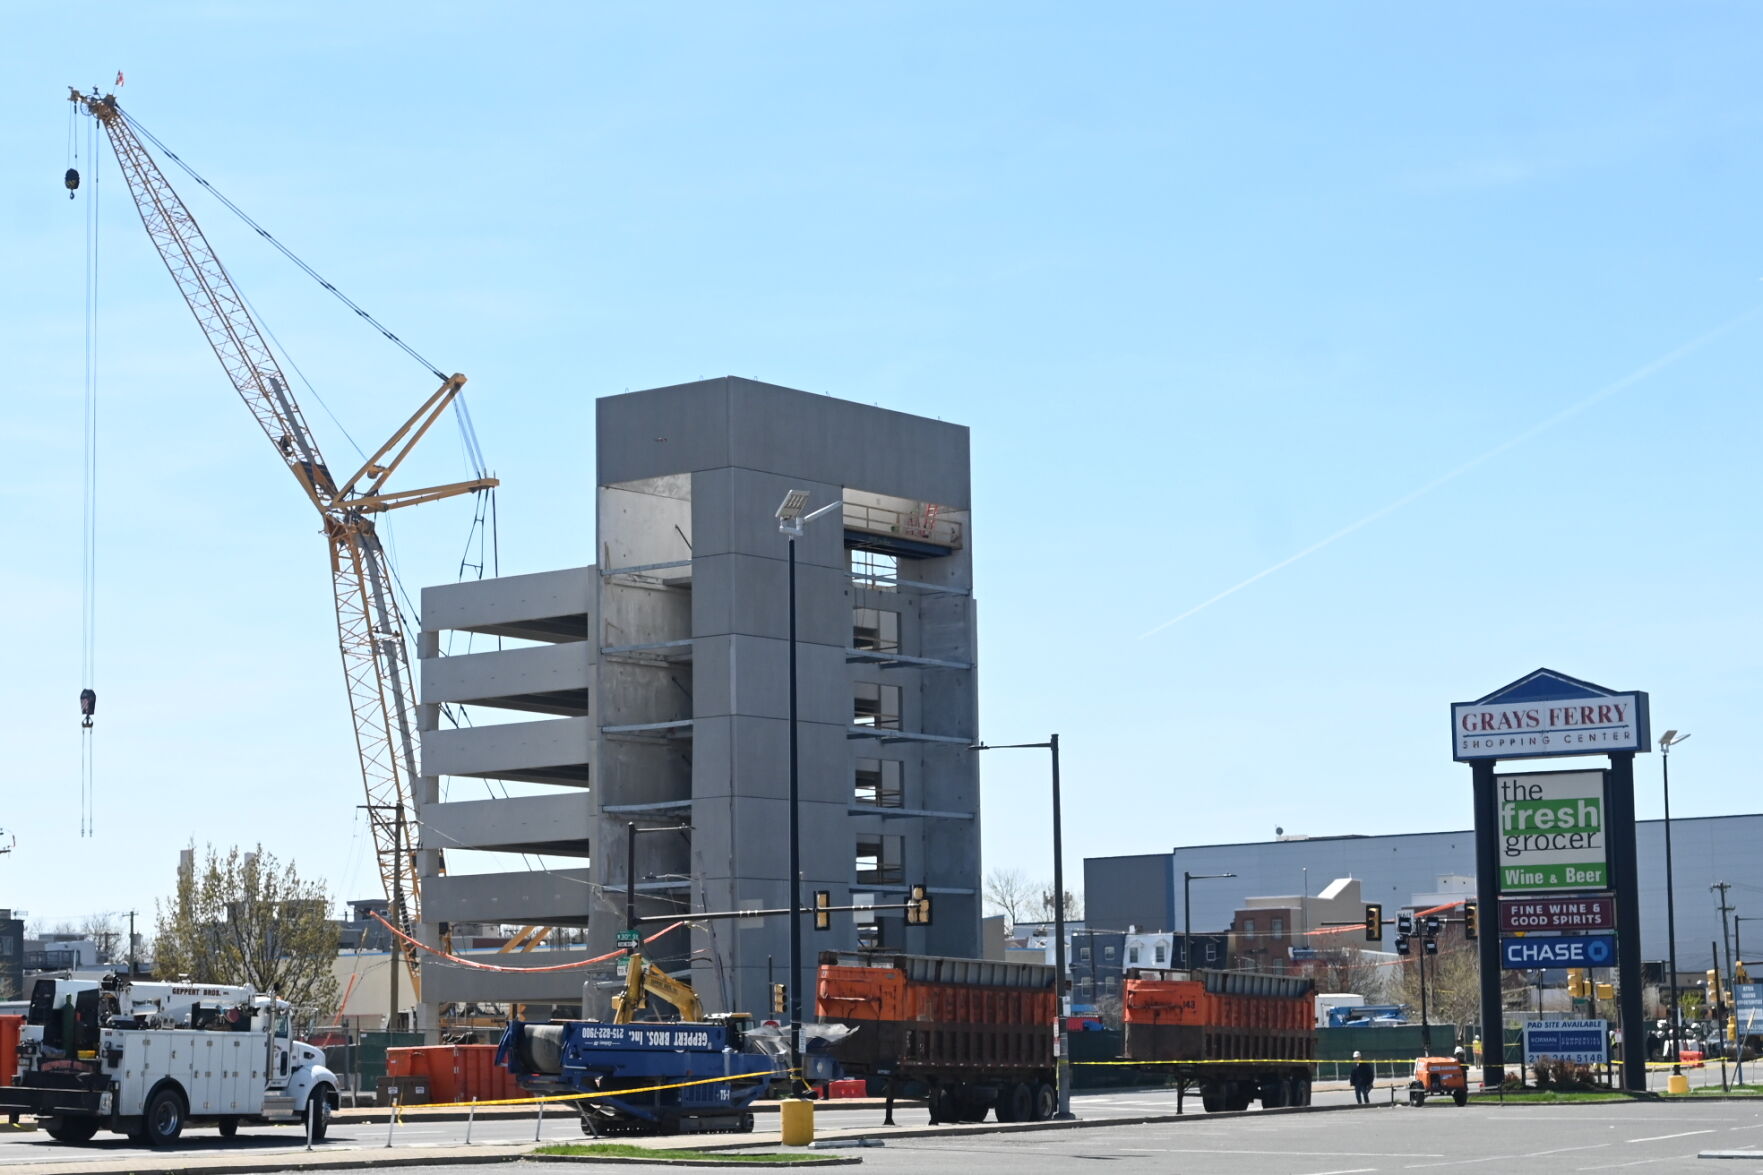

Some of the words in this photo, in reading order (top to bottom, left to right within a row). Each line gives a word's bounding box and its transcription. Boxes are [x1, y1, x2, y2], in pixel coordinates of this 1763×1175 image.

[1462, 709, 1540, 732] GRAYS
[1550, 703, 1627, 727] FERRY
[1463, 735, 1550, 749] SHOPPING
[1564, 731, 1630, 744] CENTER
[1501, 780, 1543, 801] the
[1502, 800, 1599, 830] fresh
[1505, 832, 1598, 857] grocer
[1505, 869, 1544, 885] Wine
[1549, 874, 1557, 884] &
[1565, 867, 1602, 883] Beer
[1511, 905, 1543, 915] FINE
[1550, 904, 1587, 914] WINE
[1593, 903, 1600, 913] &
[1511, 915, 1548, 926] GOOD
[1553, 914, 1602, 925] SPIRITS
[1507, 943, 1584, 961] CHASE
[1561, 1020, 1601, 1028] AVAILABLE
[628, 1030, 643, 1045] Inc.
[647, 1031, 670, 1046] BROS.
[673, 1032, 708, 1047] GEPPERT
